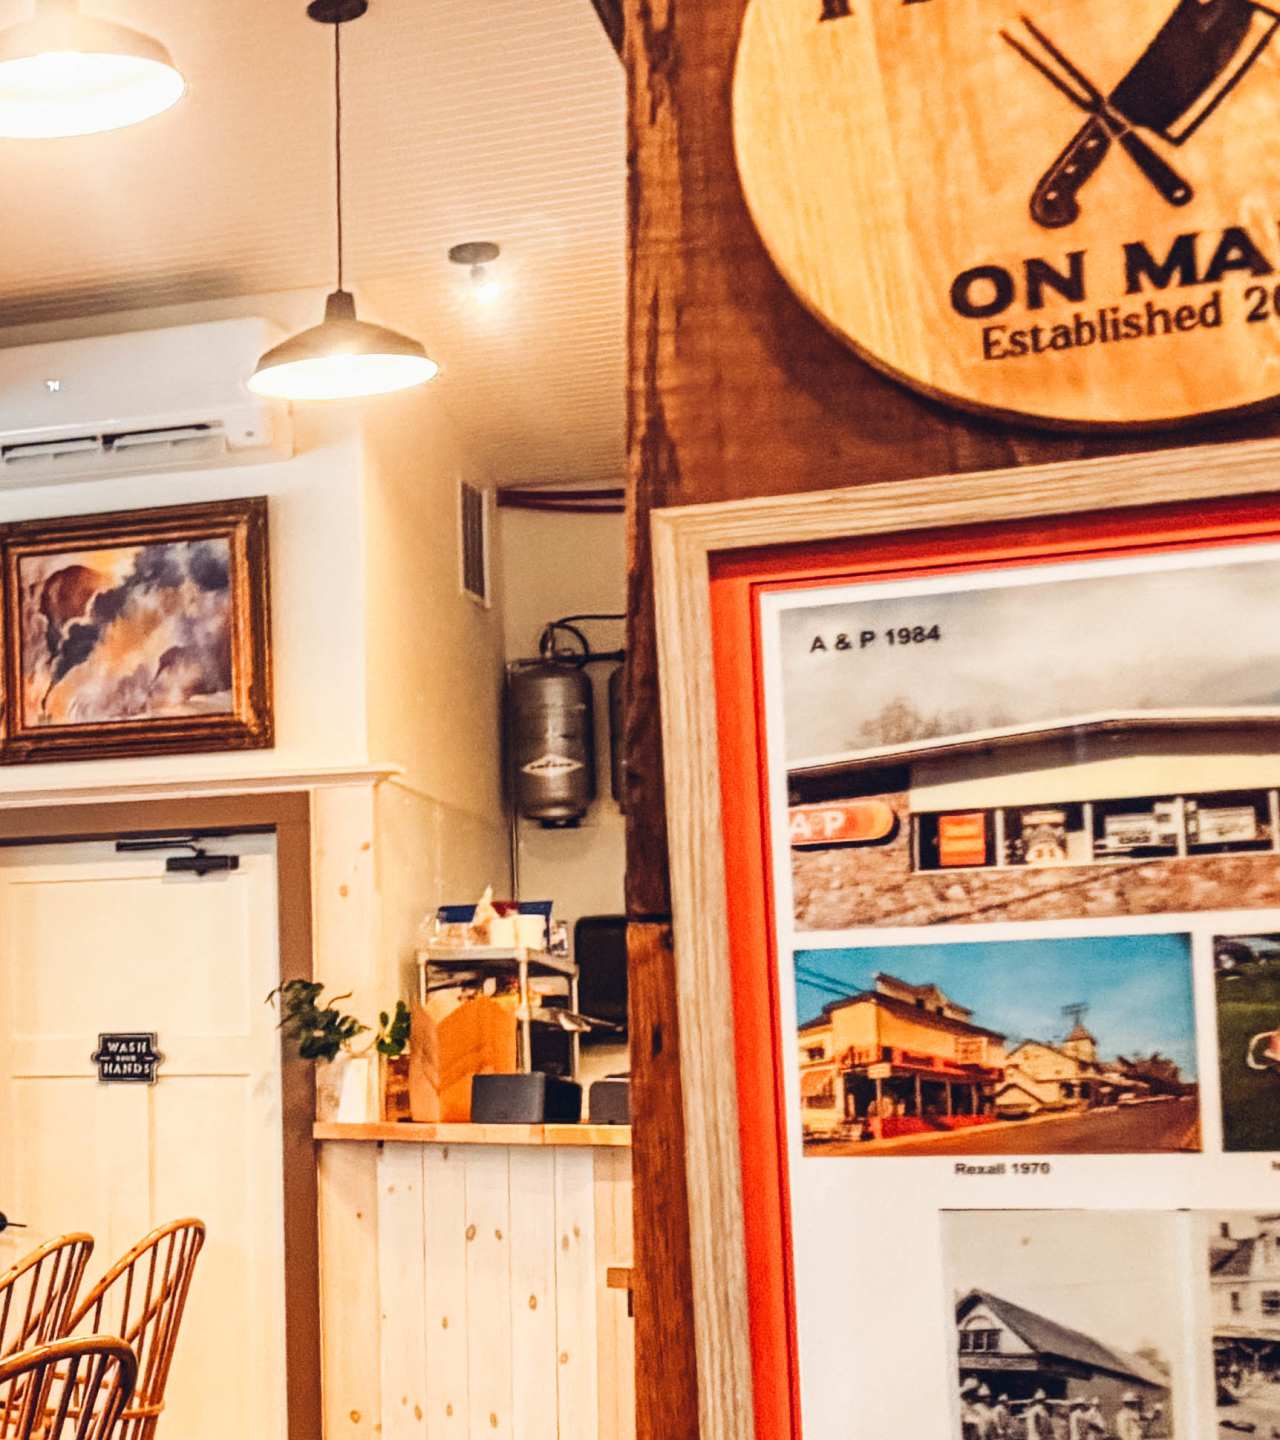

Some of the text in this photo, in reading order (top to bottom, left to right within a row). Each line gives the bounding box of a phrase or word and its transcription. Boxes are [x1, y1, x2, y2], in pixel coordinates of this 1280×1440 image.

[949, 222, 1280, 319] ON MA
[981, 291, 1223, 361] Established
[809, 625, 941, 653] A & P 1984
[107, 1042, 147, 1053] WASH
[103, 1063, 151, 1074] HANDS
[954, 1162, 1051, 1175] Rexall 1970
